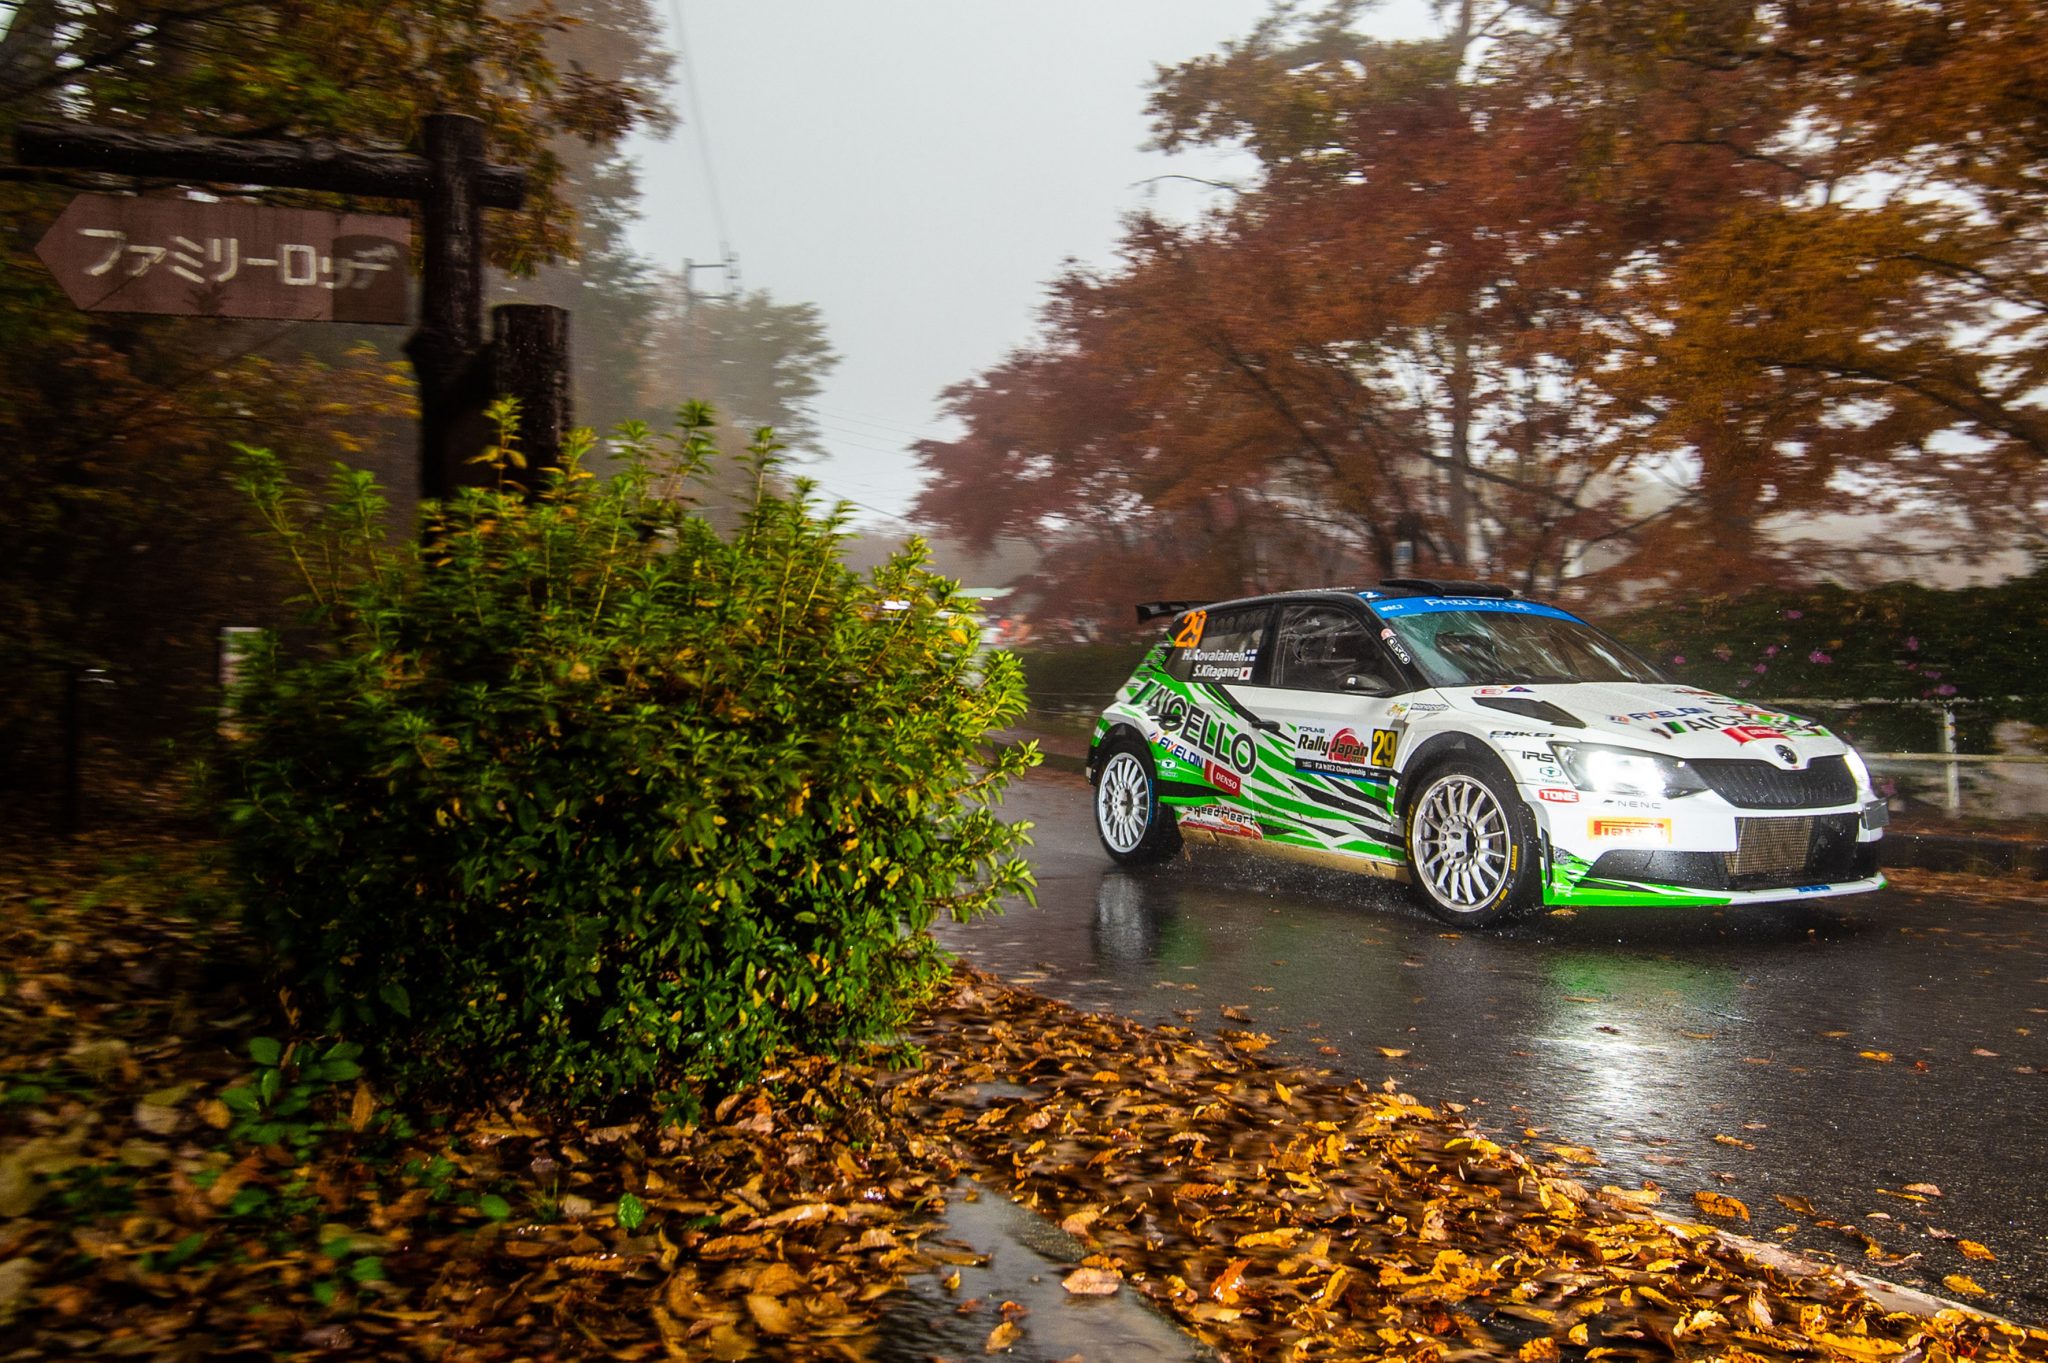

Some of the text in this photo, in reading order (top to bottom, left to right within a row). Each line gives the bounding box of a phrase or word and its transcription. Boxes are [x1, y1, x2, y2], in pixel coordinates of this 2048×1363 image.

[1174, 610, 1207, 648] 29
[1192, 664, 1240, 680] S.Kitagawa
[1159, 736, 1204, 769] FIXELON
[1297, 733, 1369, 758] Rally Japan
[1371, 730, 1396, 767] 29
[1522, 750, 1555, 763] IRS
[1215, 772, 1238, 790] DENSO
[1542, 791, 1577, 802] TONE
